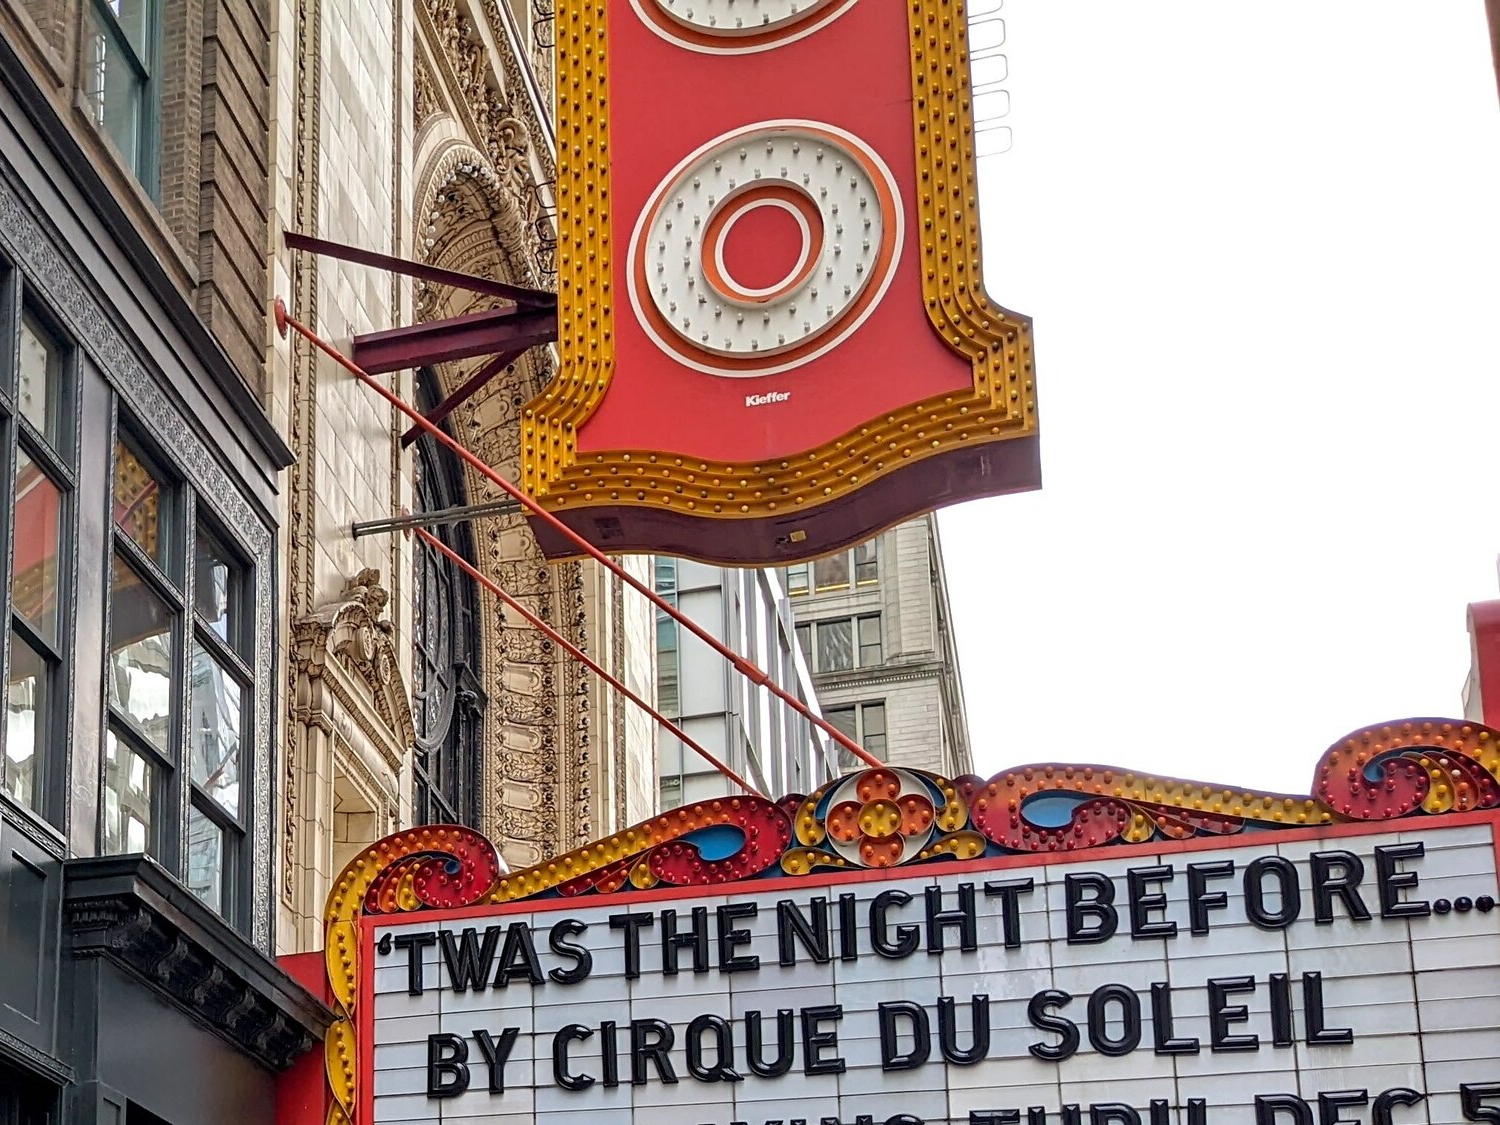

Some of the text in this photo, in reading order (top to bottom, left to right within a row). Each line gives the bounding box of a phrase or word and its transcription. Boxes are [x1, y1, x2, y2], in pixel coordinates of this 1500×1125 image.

[744, 391, 791, 407] Kieffer
[608, 901, 760, 979] THE
[776, 876, 1035, 968] NIGHT
[426, 970, 1354, 1099] BY CIRQUE DU SOLEIL
